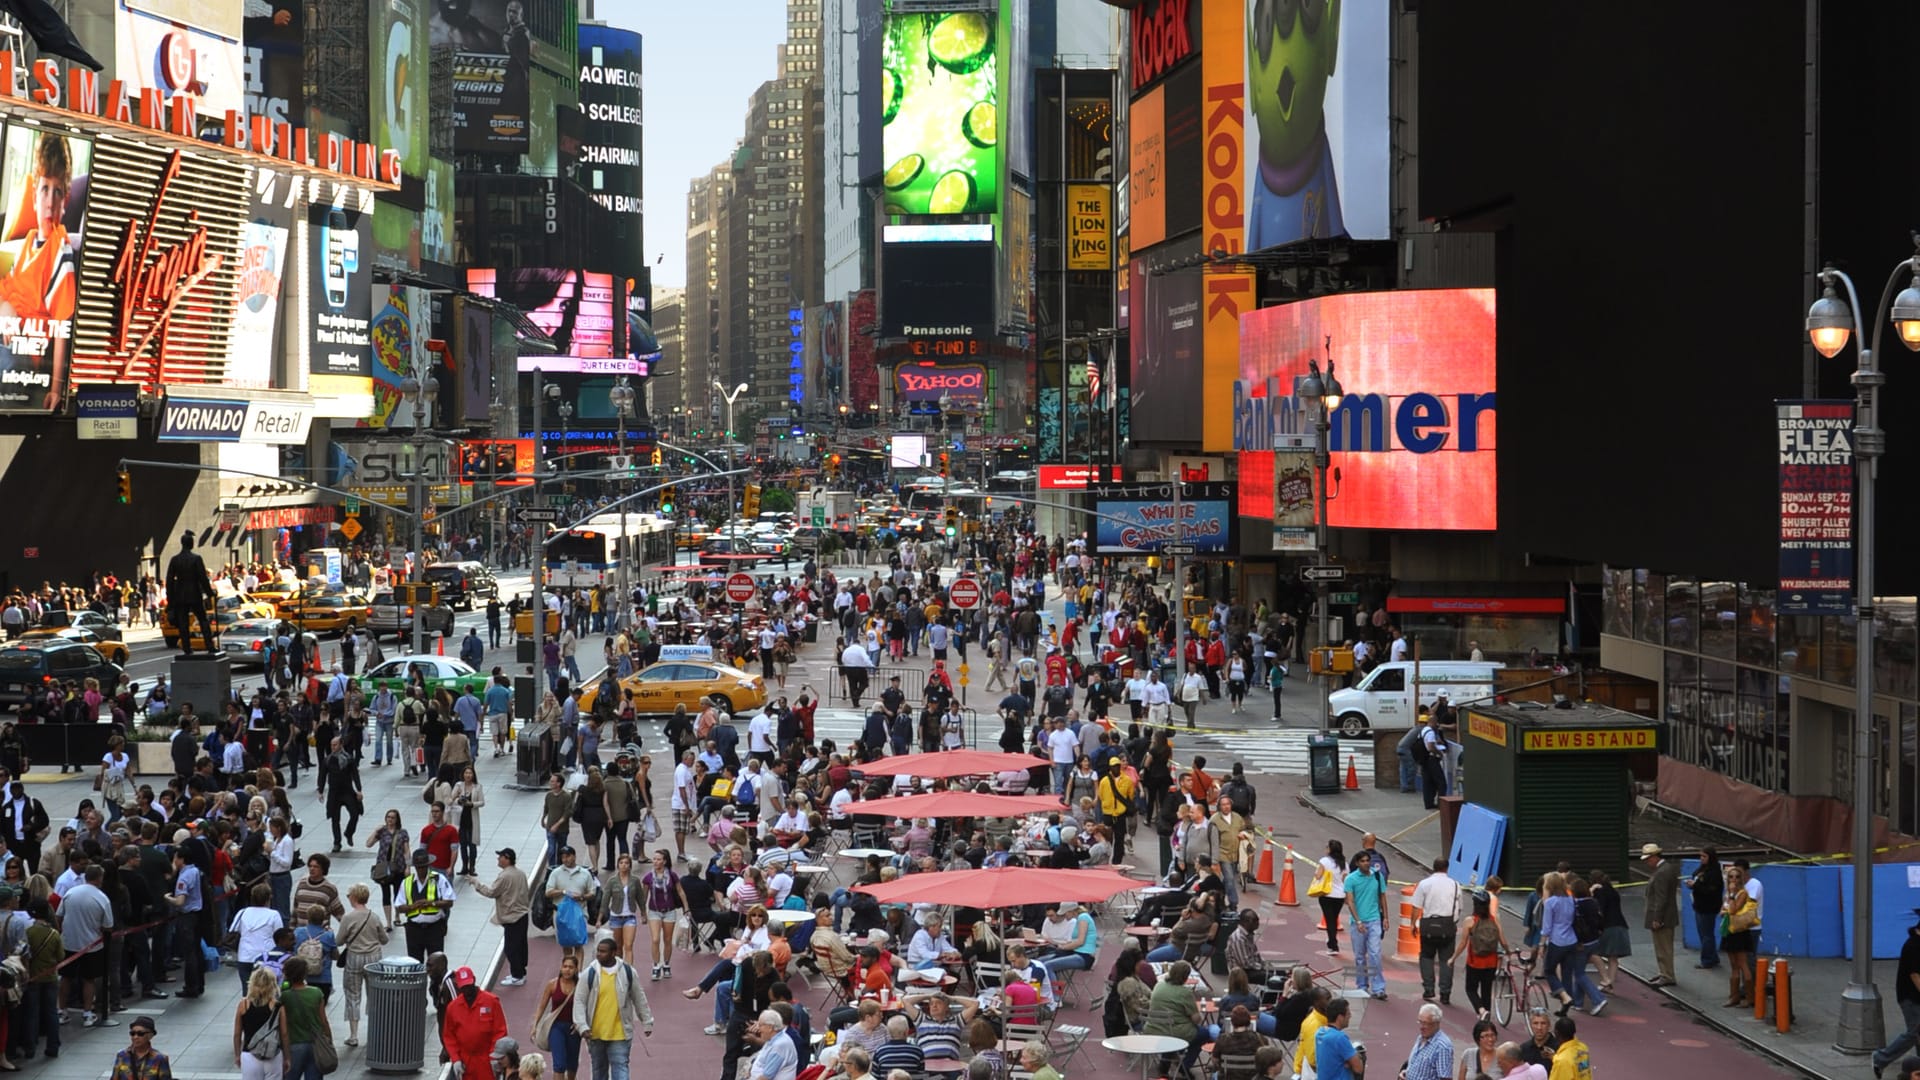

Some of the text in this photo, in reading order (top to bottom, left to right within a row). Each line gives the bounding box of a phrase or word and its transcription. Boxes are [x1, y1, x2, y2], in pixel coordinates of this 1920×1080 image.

[489, 119, 525, 129] SPIKE
[225, 110, 401, 185] BUILDING
[1077, 201, 1101, 212] THE
[1073, 215, 1105, 236] LION
[1073, 239, 1106, 259] KING
[22, 318, 47, 337] ALL
[47, 319, 72, 339] THE
[903, 325, 973, 335] Panasonic
[11, 336, 49, 355] TIME?
[900, 372, 982, 391] YAHOO!
[77, 399, 137, 408] VORNADO
[166, 407, 302, 434] VORNADO Retail
[1233, 376, 1276, 451] Bank
[93, 419, 121, 431] Retail
[1778, 419, 1852, 429] BROADWAY
[1779, 429, 1852, 451] FLEA
[1780, 452, 1852, 464] MARKET
[1097, 485, 1231, 498] MARQUIS
[1782, 493, 1816, 503] SUNDAY,
[1818, 493, 1838, 503] SEPT.
[1140, 503, 1197, 521] WHITE
[1782, 503, 1851, 514] 10AM-7PM
[1782, 518, 1850, 527] SHUBERT ALLEY
[1121, 517, 1221, 549] CHRISTMAS
[1822, 528, 1850, 537] STREET
[662, 648, 709, 656] BARCELONA
[1470, 715, 1504, 741] NEWSSTAND
[1531, 731, 1647, 748] NEWSSTAND
